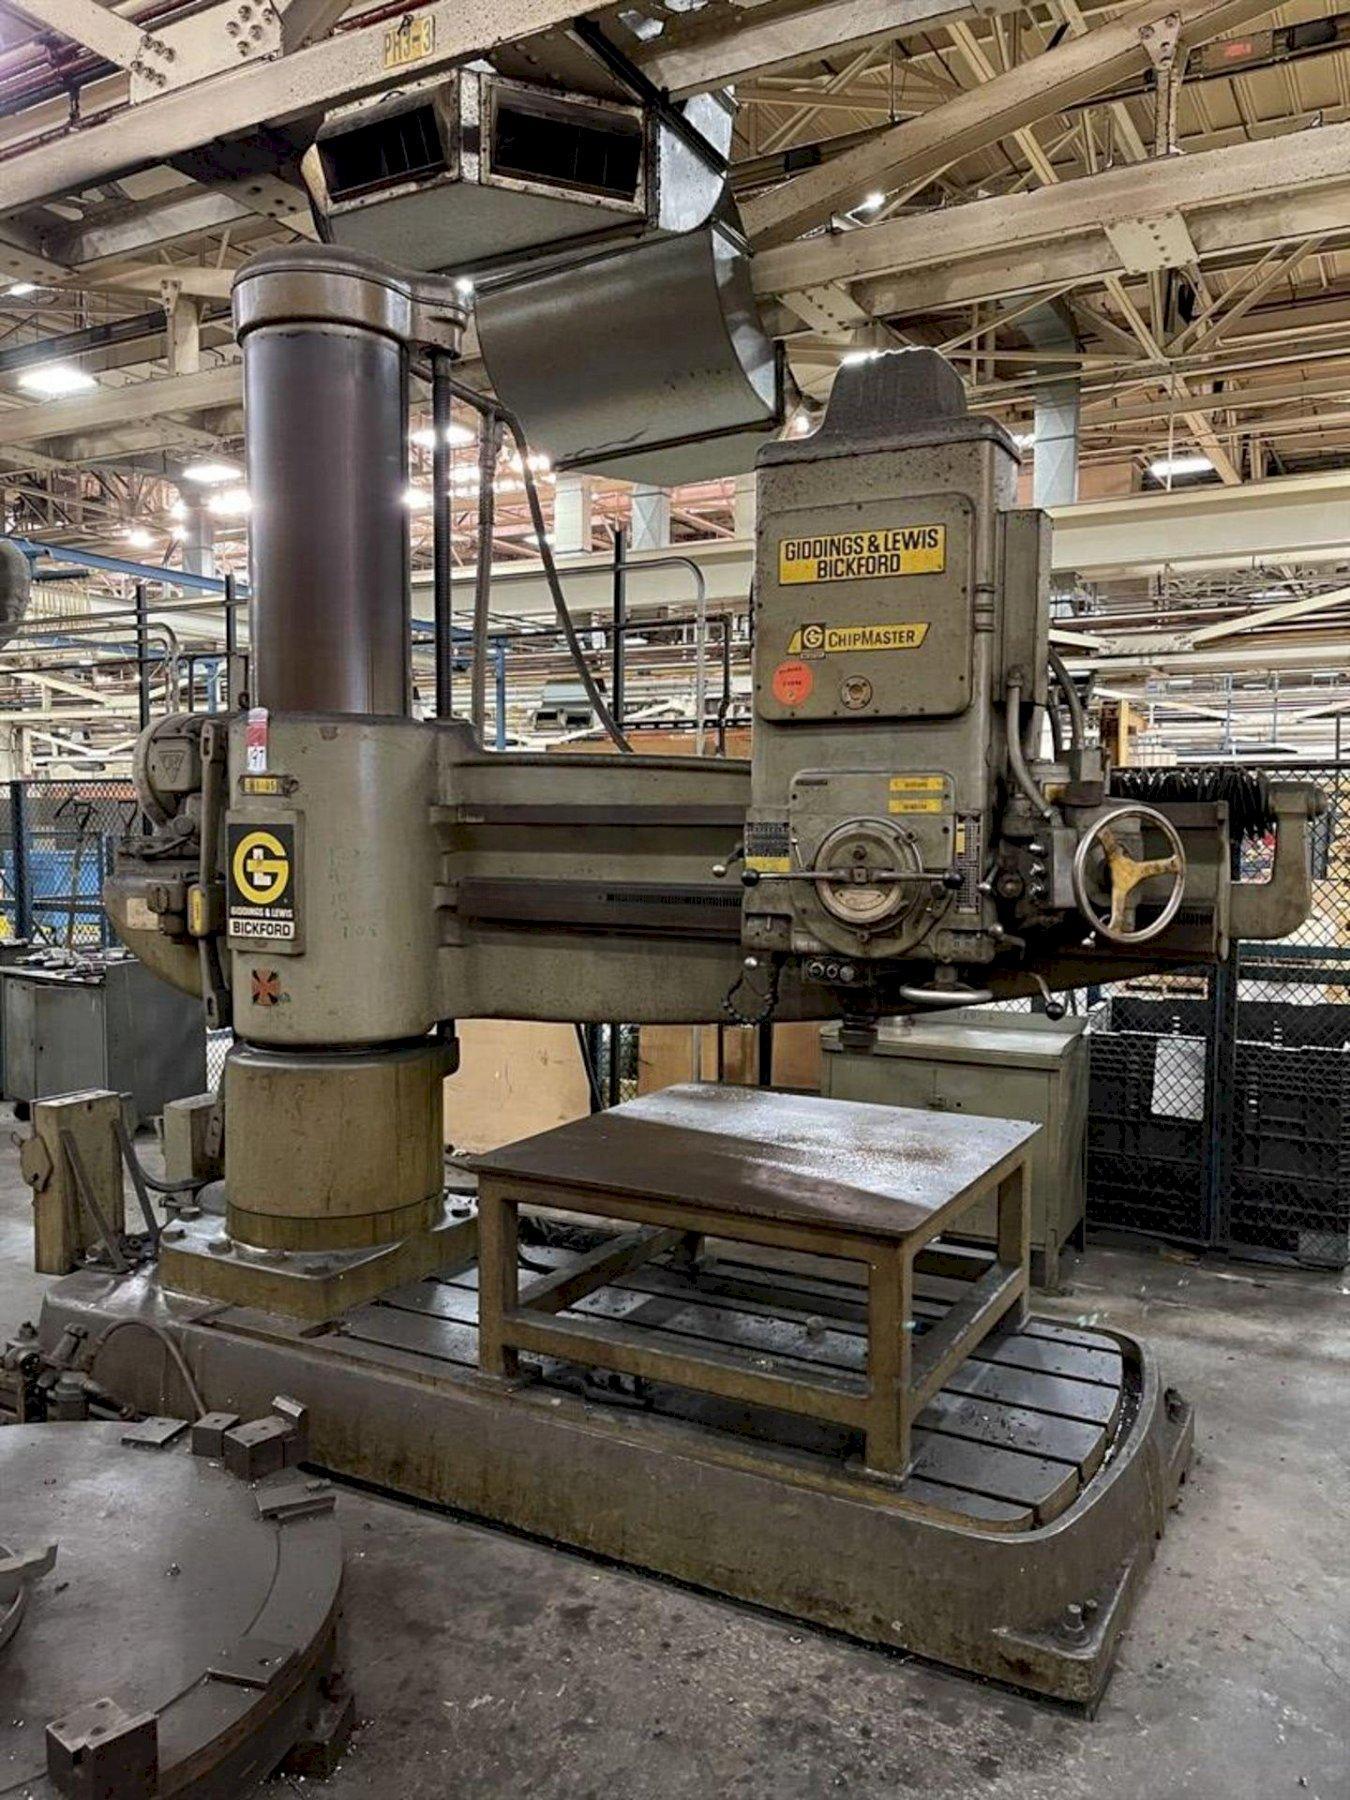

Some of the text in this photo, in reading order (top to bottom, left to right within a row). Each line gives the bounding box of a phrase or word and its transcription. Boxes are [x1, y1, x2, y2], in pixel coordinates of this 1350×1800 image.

[784, 528, 939, 561] GIDDINGS & LEWIS
[816, 554, 901, 578] BICKFORD
[233, 921, 291, 936] BICKFORD
